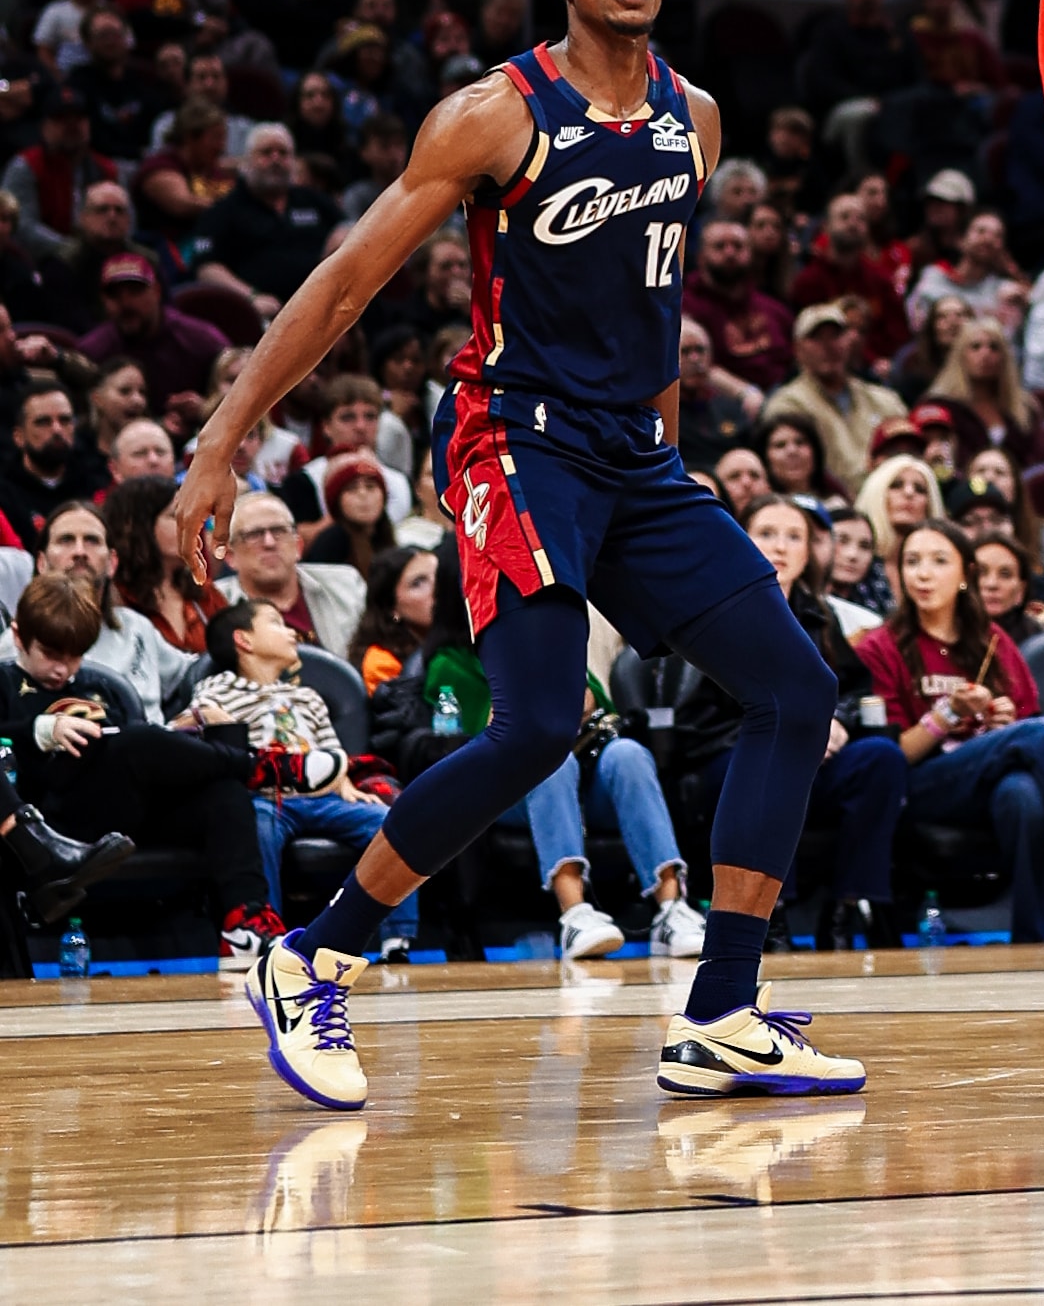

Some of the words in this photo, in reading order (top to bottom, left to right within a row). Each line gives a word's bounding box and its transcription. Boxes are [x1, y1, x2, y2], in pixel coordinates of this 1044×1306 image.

[559, 126, 585, 140] NIKE
[655, 136, 688, 148] CLIFFS
[533, 173, 691, 245] CLEVELAND
[644, 222, 682, 288] 12
